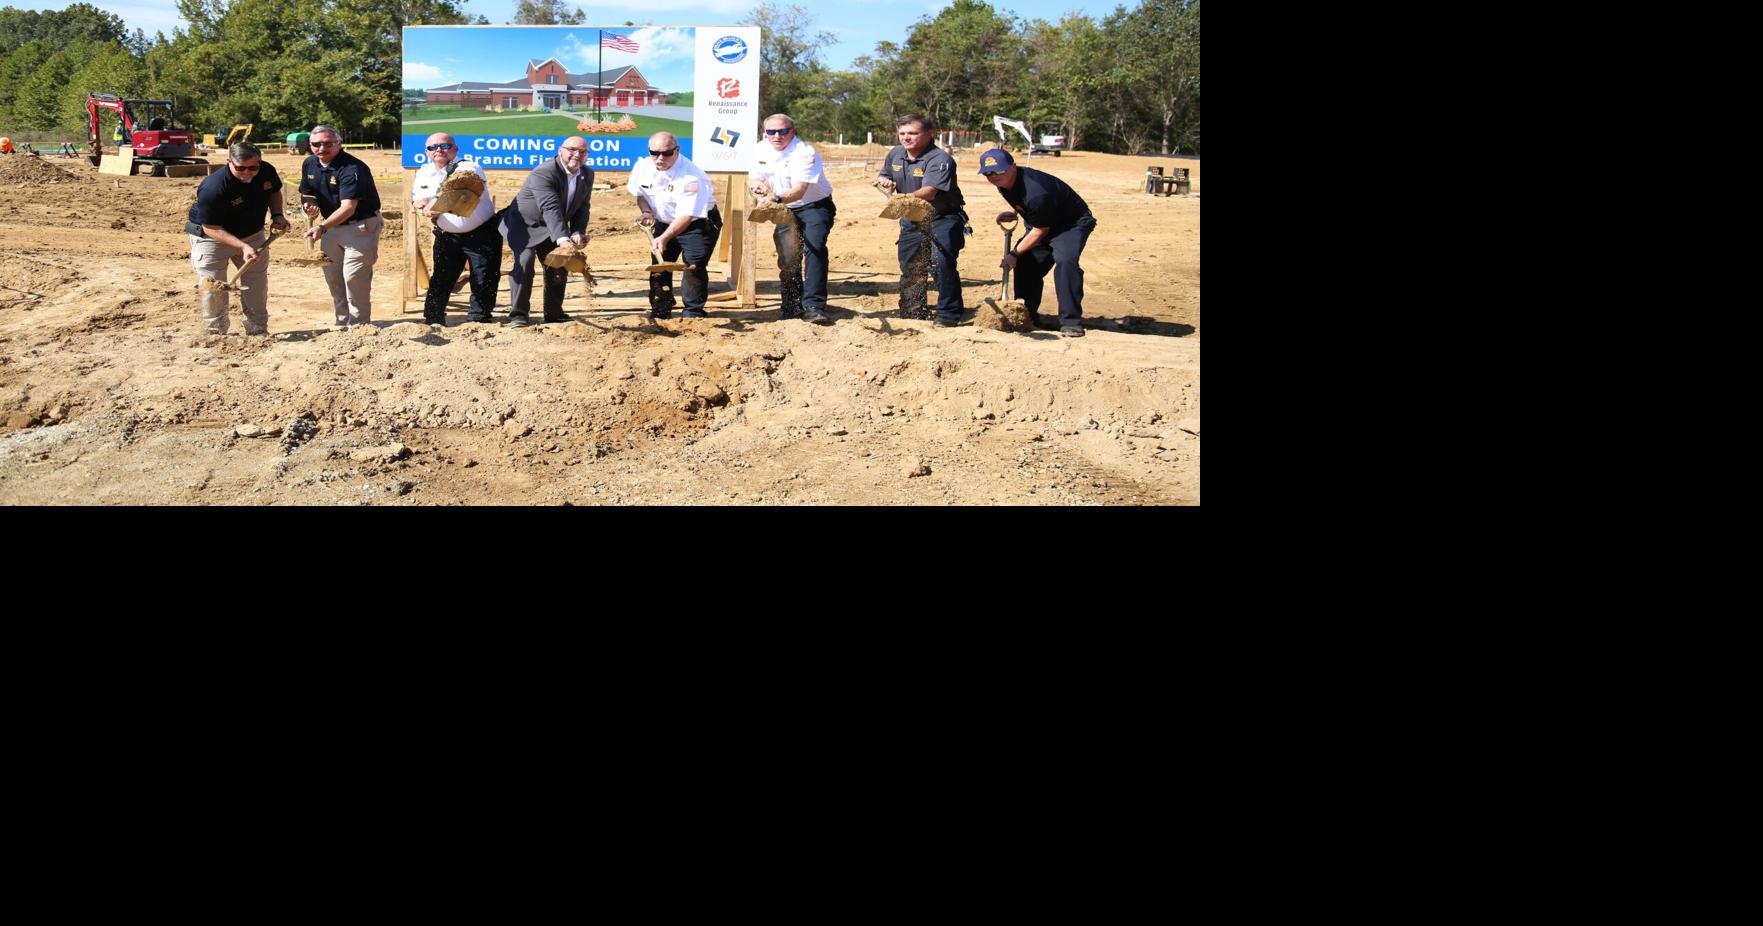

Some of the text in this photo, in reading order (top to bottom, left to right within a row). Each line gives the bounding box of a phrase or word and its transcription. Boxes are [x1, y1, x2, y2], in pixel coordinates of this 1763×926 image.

[718, 107, 738, 115] Group
[473, 138, 620, 152] COMING ON
[463, 154, 523, 165] Branch
[585, 155, 631, 167] ation
